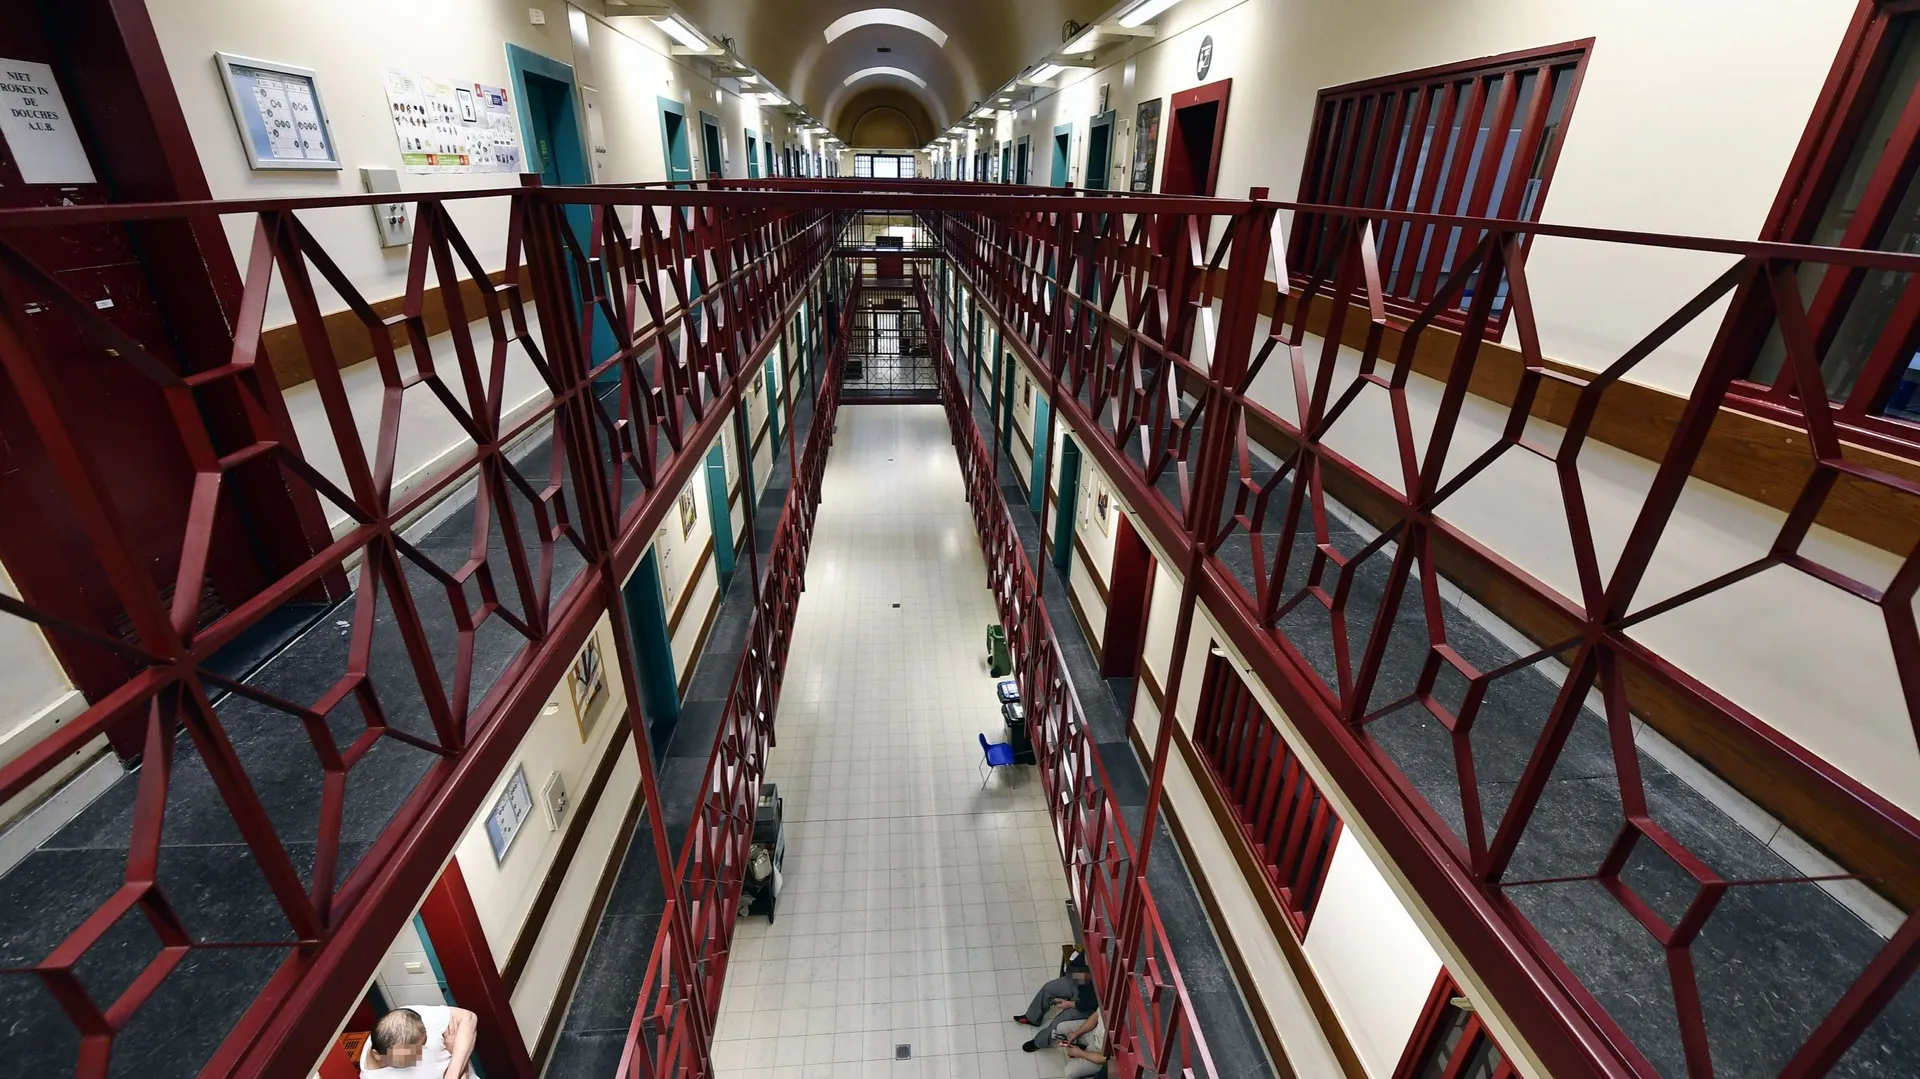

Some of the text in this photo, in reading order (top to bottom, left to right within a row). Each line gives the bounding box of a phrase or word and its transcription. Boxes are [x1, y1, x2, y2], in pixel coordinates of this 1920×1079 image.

[6, 71, 31, 82] NIET
[0, 83, 49, 95] ROKEN IN
[23, 97, 38, 106] DE
[11, 108, 59, 120] DOUCHES
[29, 122, 55, 131] A.U.B.
